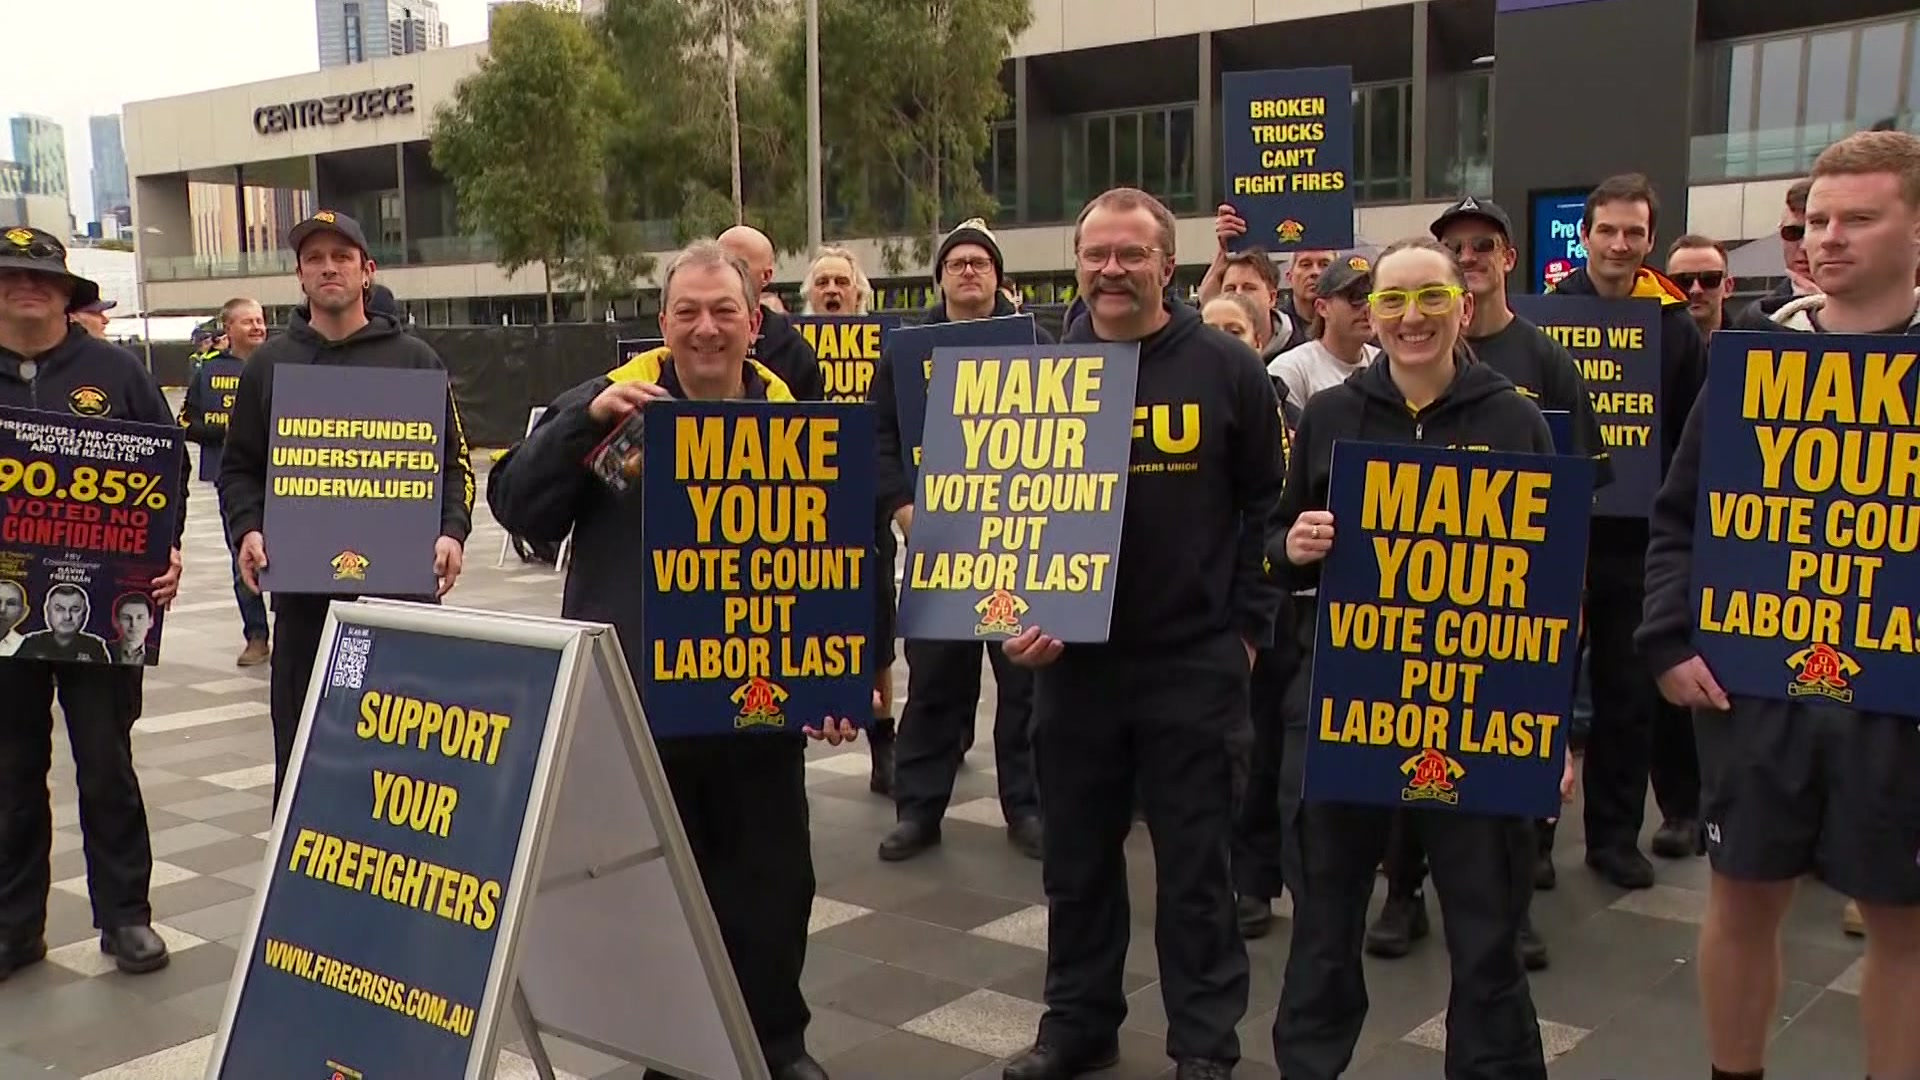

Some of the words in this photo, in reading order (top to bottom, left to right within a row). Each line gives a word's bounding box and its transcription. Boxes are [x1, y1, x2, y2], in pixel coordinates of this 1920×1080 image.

[253, 83, 414, 135] CENTREPIECE
[1250, 98, 1325, 119] BROKEN
[1251, 123, 1325, 144] TRUCKS
[1262, 148, 1316, 168] CAN'T
[1234, 175, 1287, 194] FIGHT
[1292, 172, 1345, 191] FIRES
[1551, 219, 1575, 239] Pre
[1607, 327, 1644, 349] WE
[952, 356, 1104, 416] MAKE
[1741, 349, 1920, 426] MAK
[85, 439, 118, 451] HAVE
[105, 432, 173, 450] CORPORATE
[277, 417, 438, 445] UNDERFUNDED,
[674, 416, 840, 481] MAKE
[960, 418, 1087, 470] YOUR
[0, 457, 167, 510] 90.85%
[271, 446, 440, 474] UNDERSTAFFED,
[1754, 425, 1920, 498] YOUR
[8, 496, 102, 520] VOTED
[109, 507, 150, 526] NO
[273, 476, 434, 500] UNDERVALUED!
[924, 474, 1002, 513] VOTE
[1008, 472, 1119, 513] COUNT
[1360, 460, 1553, 543] MAKE
[2, 515, 148, 554] CONFIDENCE
[686, 485, 828, 544] YOUR
[978, 516, 1048, 551] PUT
[1708, 491, 1816, 545] VOTE
[1824, 499, 1920, 553] COU
[652, 548, 741, 592] VOTE
[750, 547, 866, 591] COUNT
[910, 552, 1019, 591] LABOR
[1024, 553, 1111, 592] LAST
[1372, 536, 1530, 609] YOUR
[1786, 550, 1884, 598] PUT
[724, 595, 797, 635] PUT
[1329, 601, 1426, 654] VOTE
[1434, 609, 1569, 664] COUNT
[1699, 586, 1843, 646] LABOR
[1854, 602, 1920, 653] LA
[653, 636, 771, 681] LABOR
[781, 634, 866, 677] LAST
[1399, 658, 1485, 704] PUT
[356, 690, 511, 766] SUPPORT
[1318, 697, 1450, 751] LABOR
[1459, 708, 1560, 759] LAST
[371, 769, 458, 838] YOUR
[288, 828, 502, 931] FIREFIGHTERS
[263, 938, 476, 1039] WWW.FIRECRISIS.COM.AU
